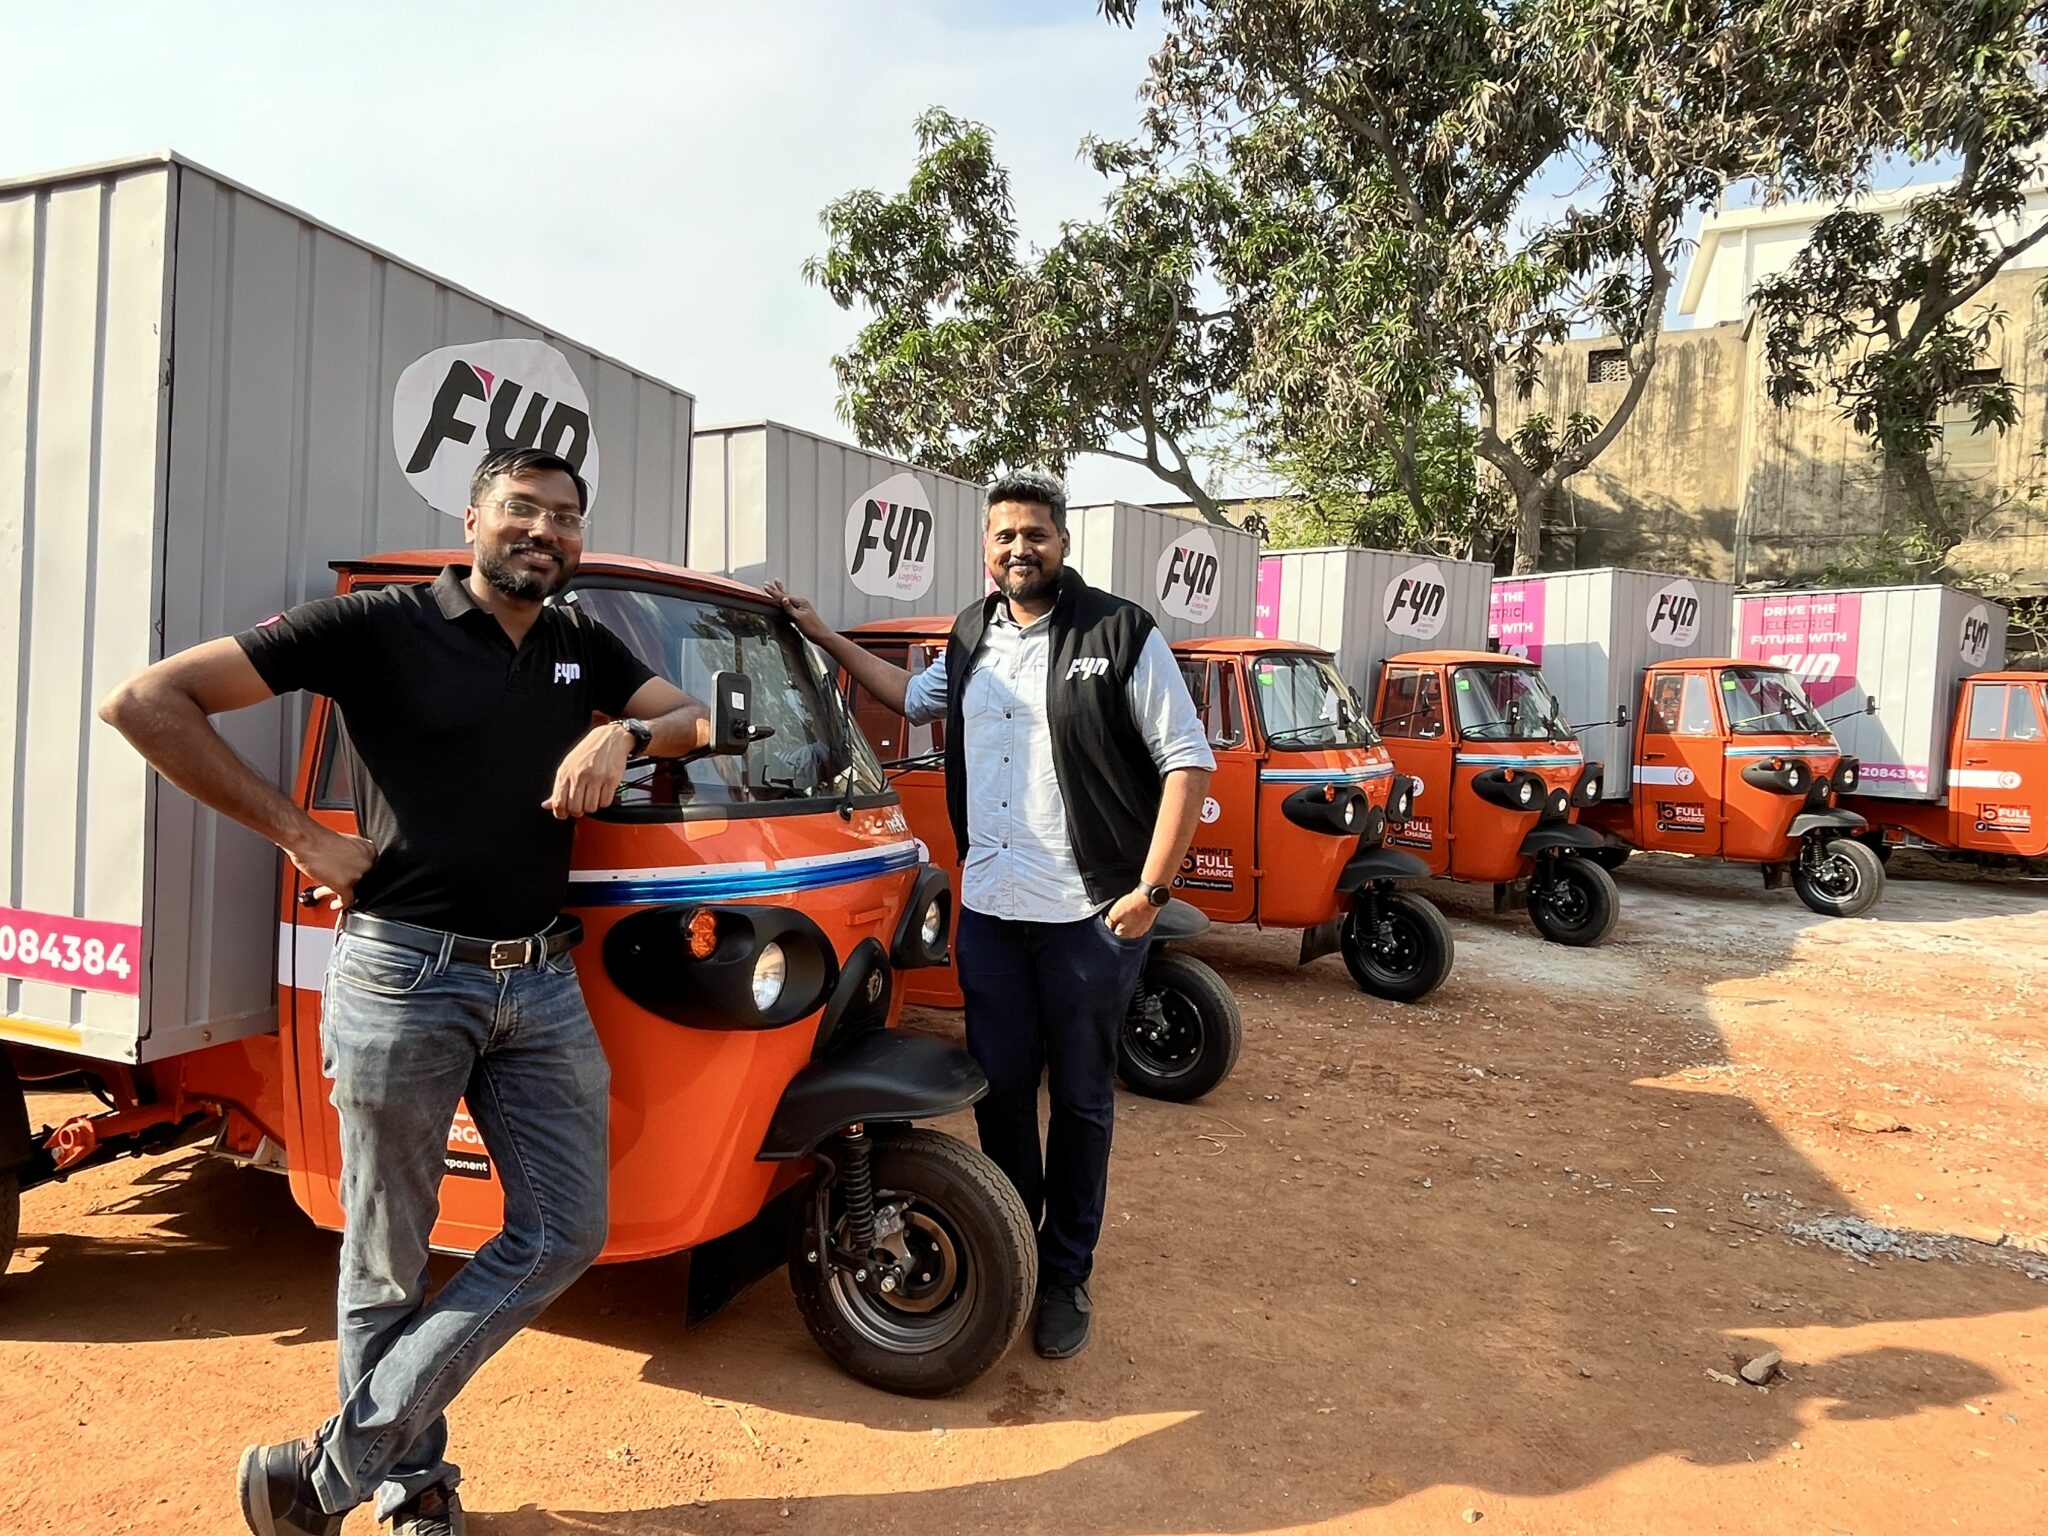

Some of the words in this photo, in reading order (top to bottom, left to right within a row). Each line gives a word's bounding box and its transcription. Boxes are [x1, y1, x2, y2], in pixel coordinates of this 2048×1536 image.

[1502, 591, 1525, 603] THE
[1764, 605, 1806, 617] DRIVE
[1810, 603, 1837, 614] THE
[1502, 622, 1534, 634] WITH
[1766, 618, 1832, 630] ELECTRIC
[1750, 634, 1804, 645] FUTURE
[1808, 632, 1847, 643] WITH
[1858, 766, 1927, 781] 2084384
[1676, 806, 1705, 817] FULL
[1976, 803, 1998, 821] 15
[1998, 808, 2031, 818] FULL
[1404, 821, 1432, 833] FULL
[1196, 847, 1233, 856] MINUTE
[1196, 855, 1233, 869] FULL
[1196, 868, 1234, 878] CHARGE
